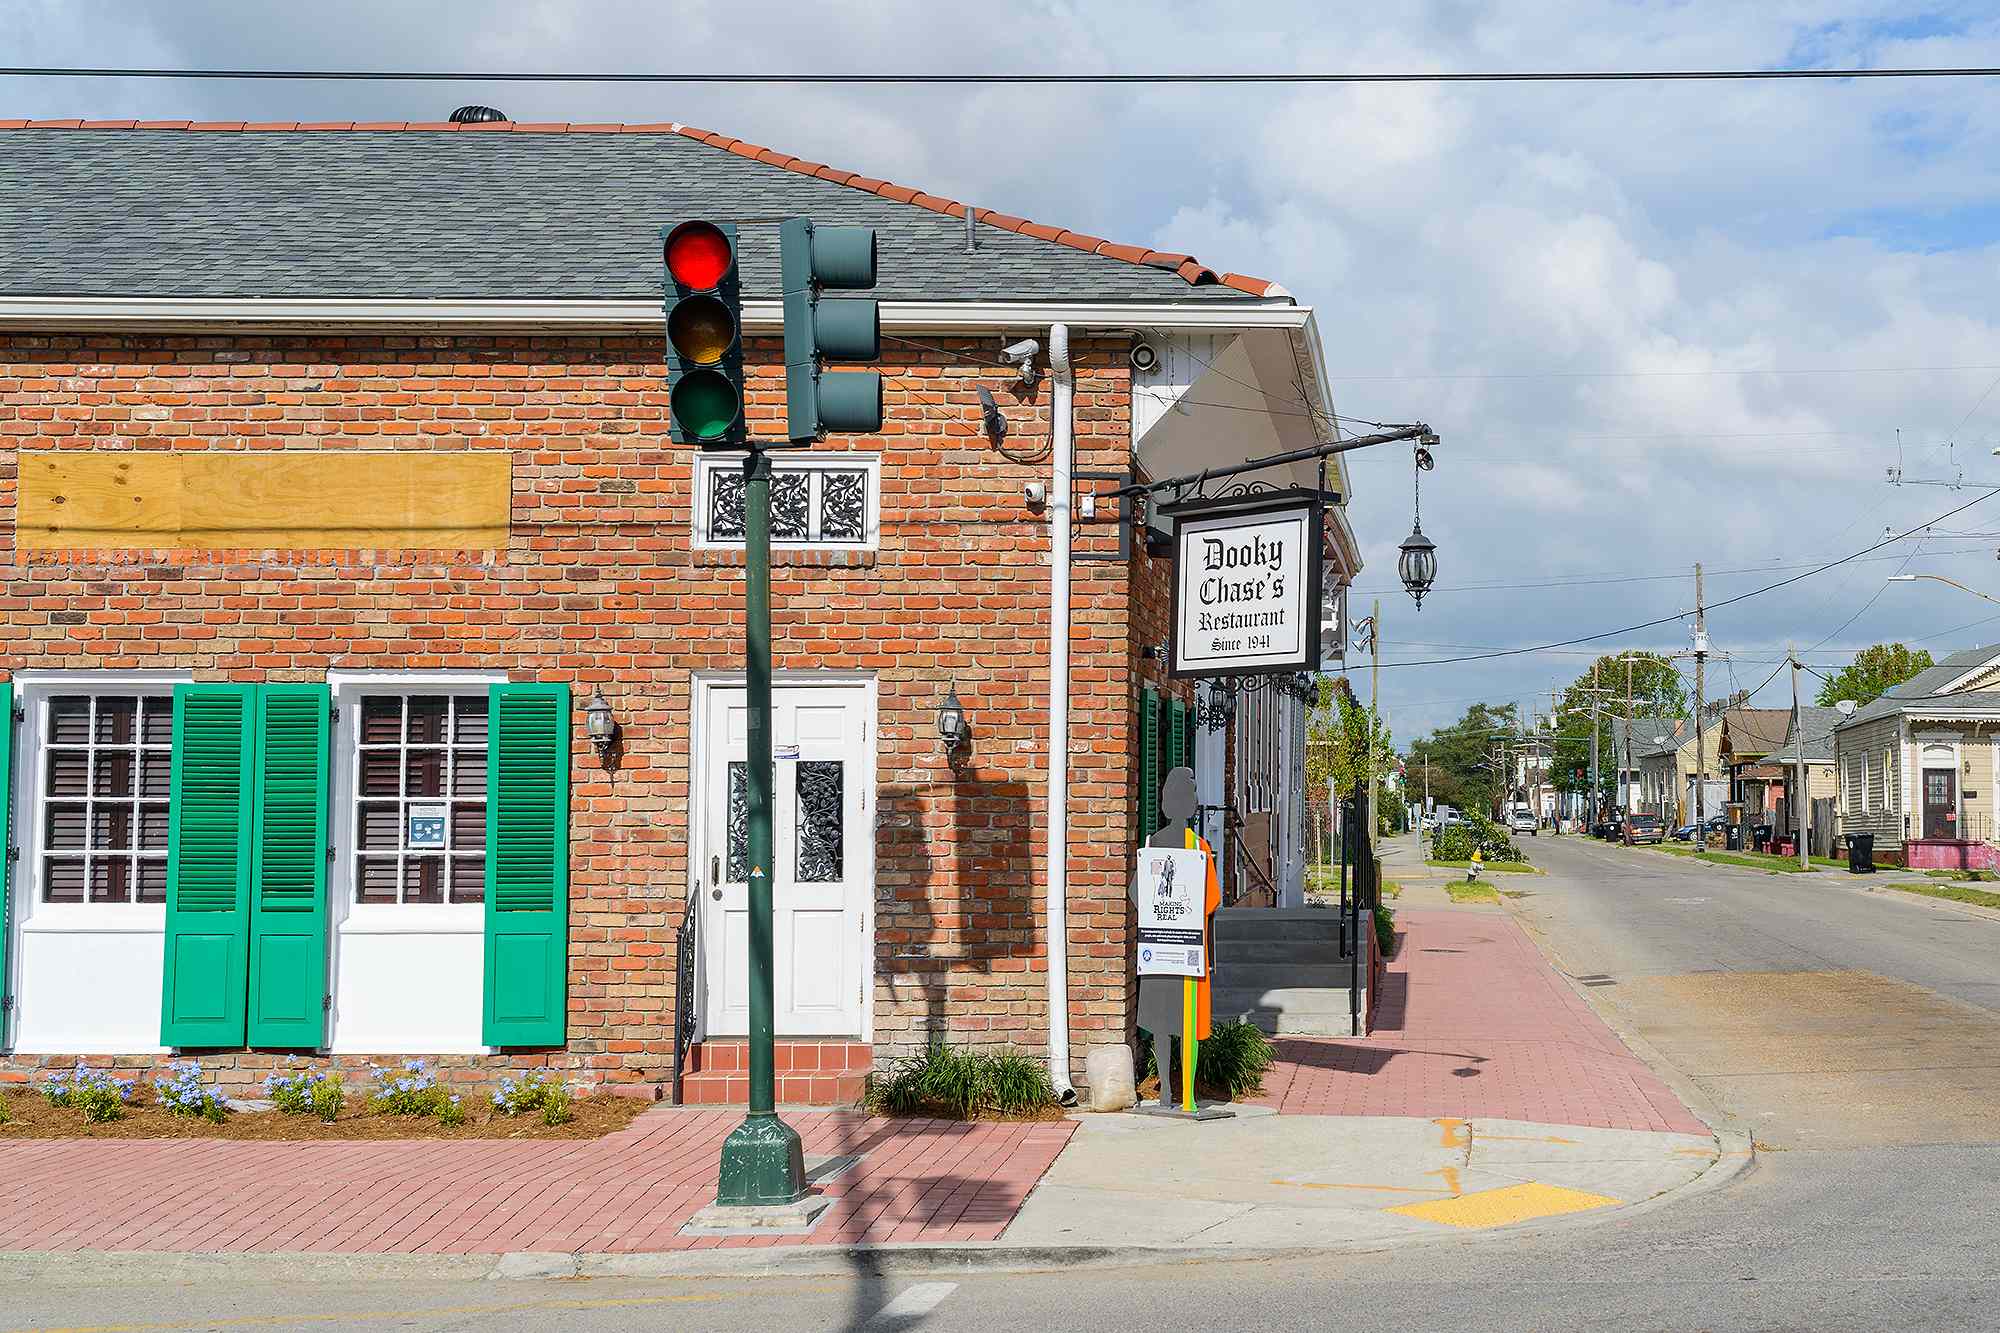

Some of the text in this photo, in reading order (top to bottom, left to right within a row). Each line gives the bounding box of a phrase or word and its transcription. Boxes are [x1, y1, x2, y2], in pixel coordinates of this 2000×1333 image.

[1202, 534, 1284, 571] Dooky
[1199, 572, 1285, 605] Chase's
[1198, 607, 1285, 632] Restaurant
[1210, 634, 1270, 652] Since 1941
[1153, 905, 1185, 915] RIGHTS
